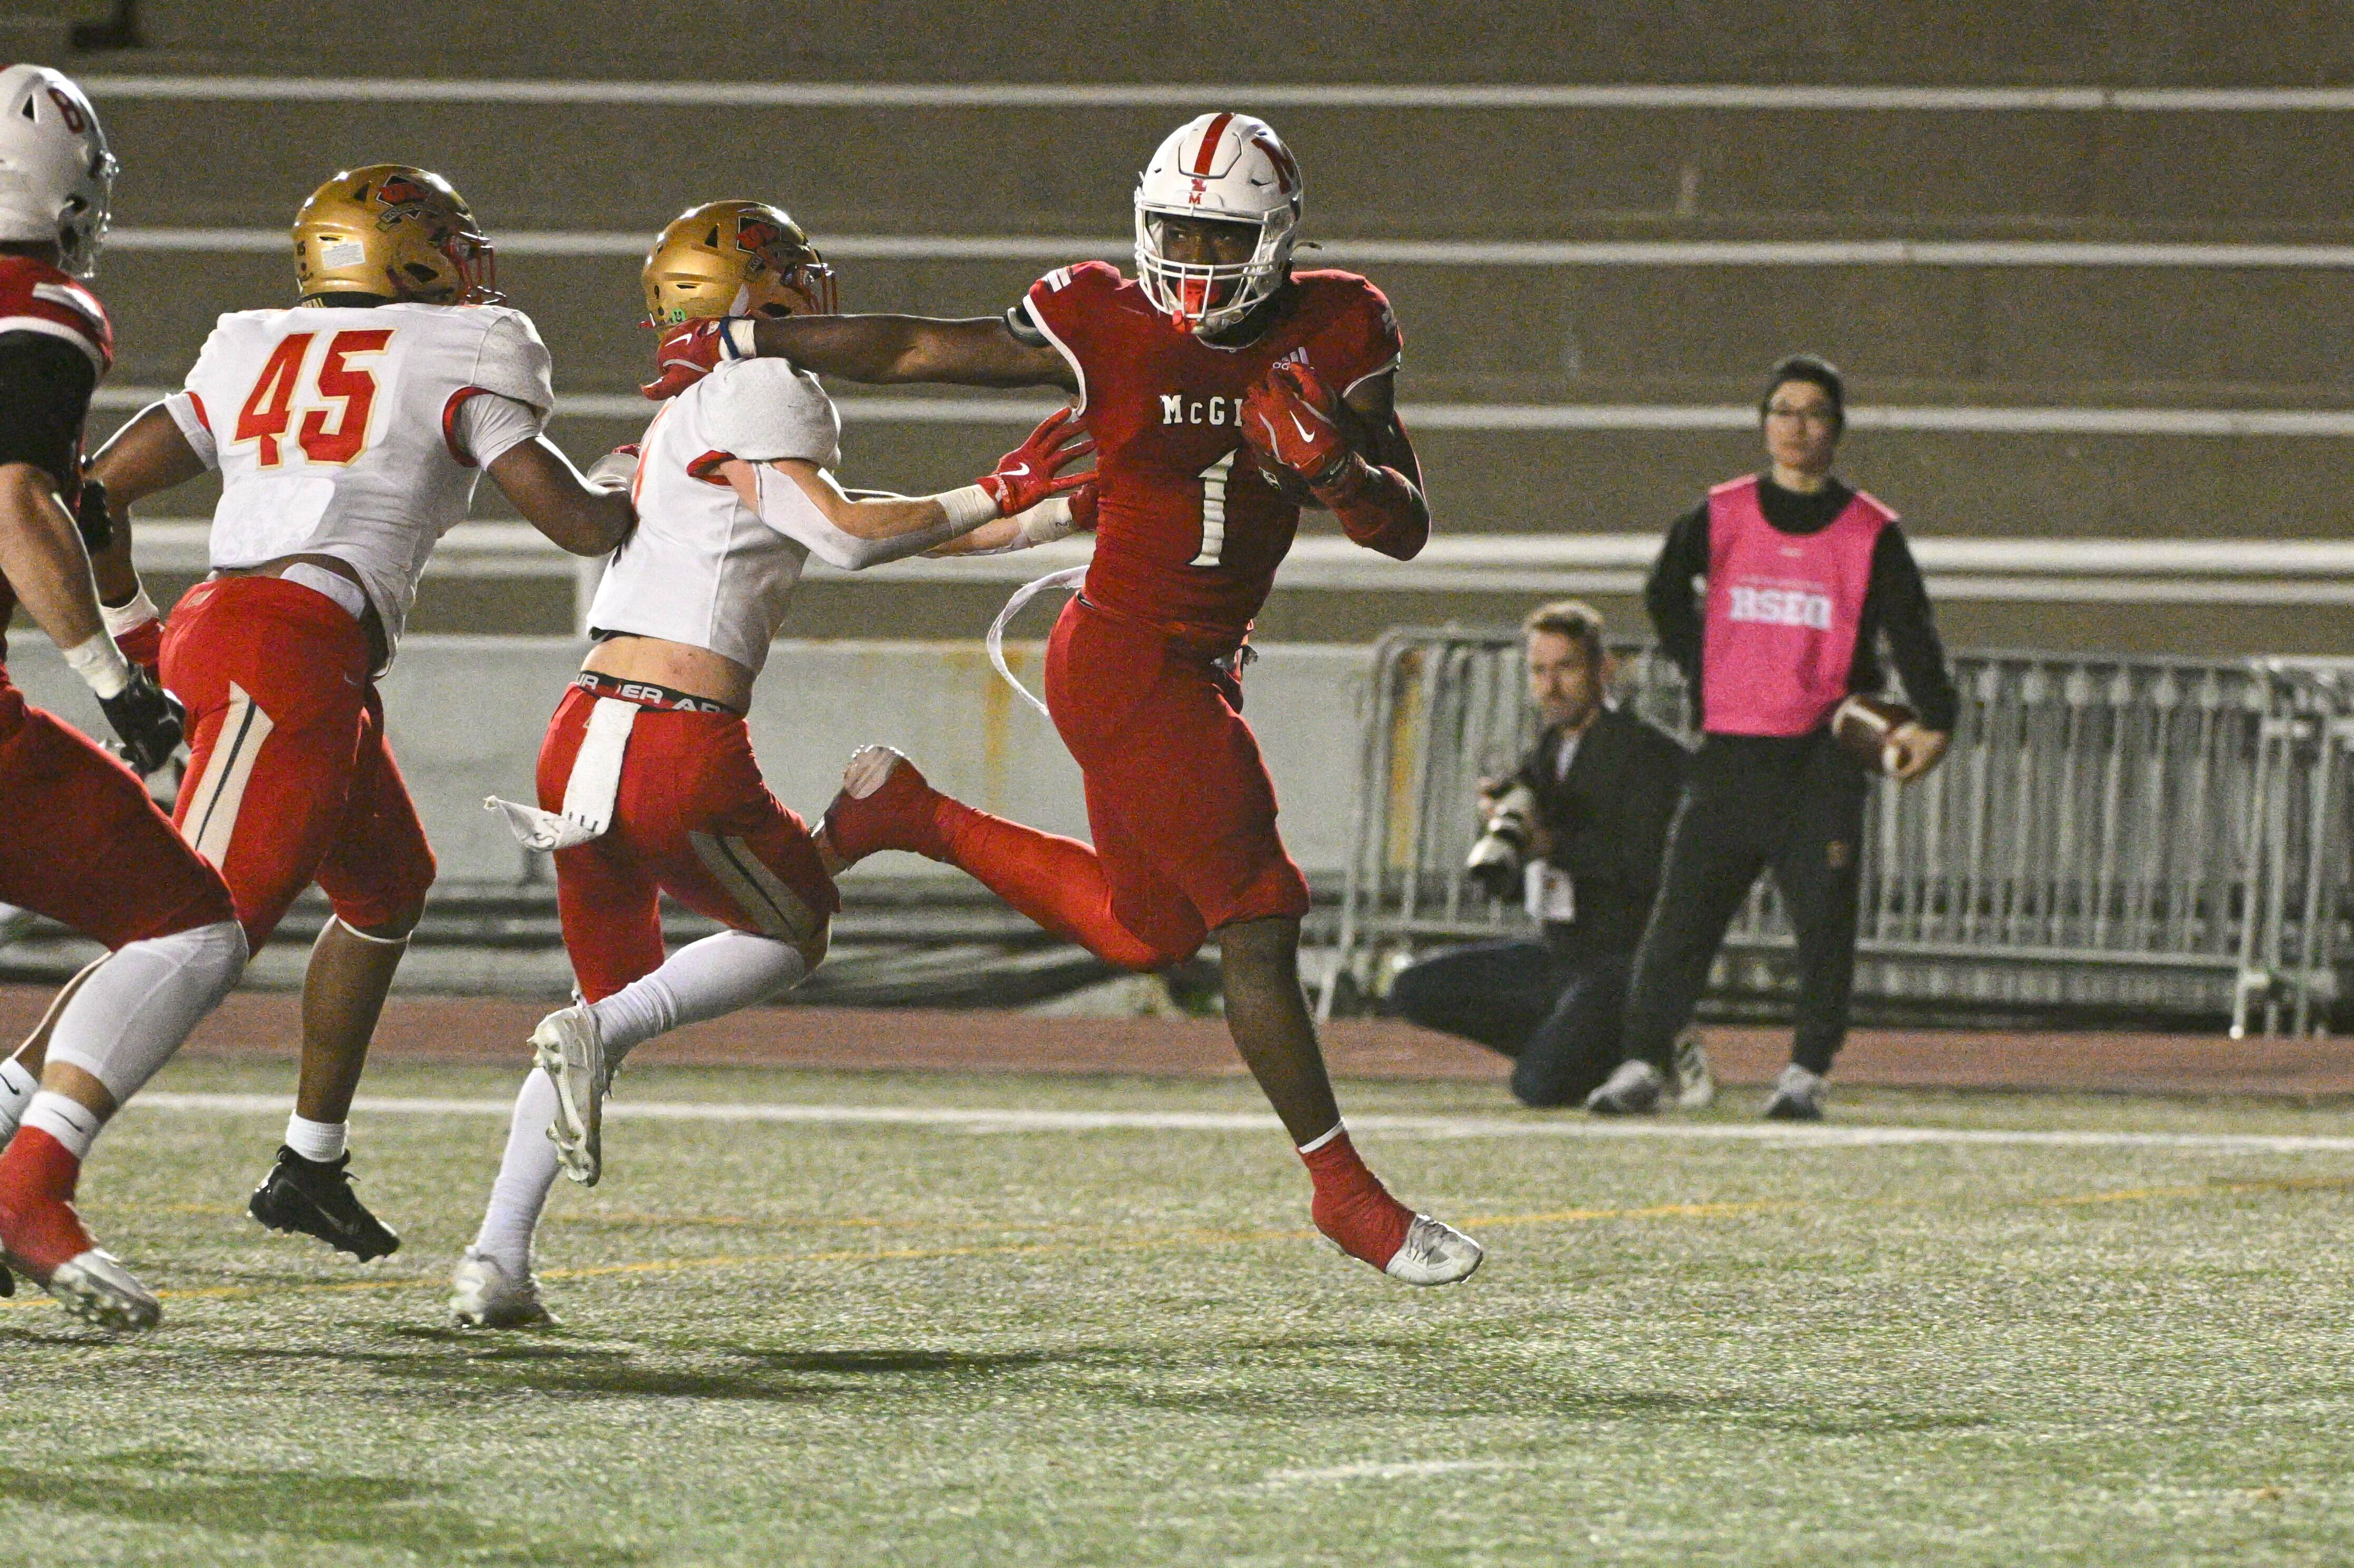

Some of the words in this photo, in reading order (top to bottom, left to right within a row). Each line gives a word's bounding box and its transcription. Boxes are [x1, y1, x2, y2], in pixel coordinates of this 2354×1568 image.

[229, 326, 401, 471] 45
[1159, 394, 1243, 427] McGI
[1189, 447, 1238, 567] 1
